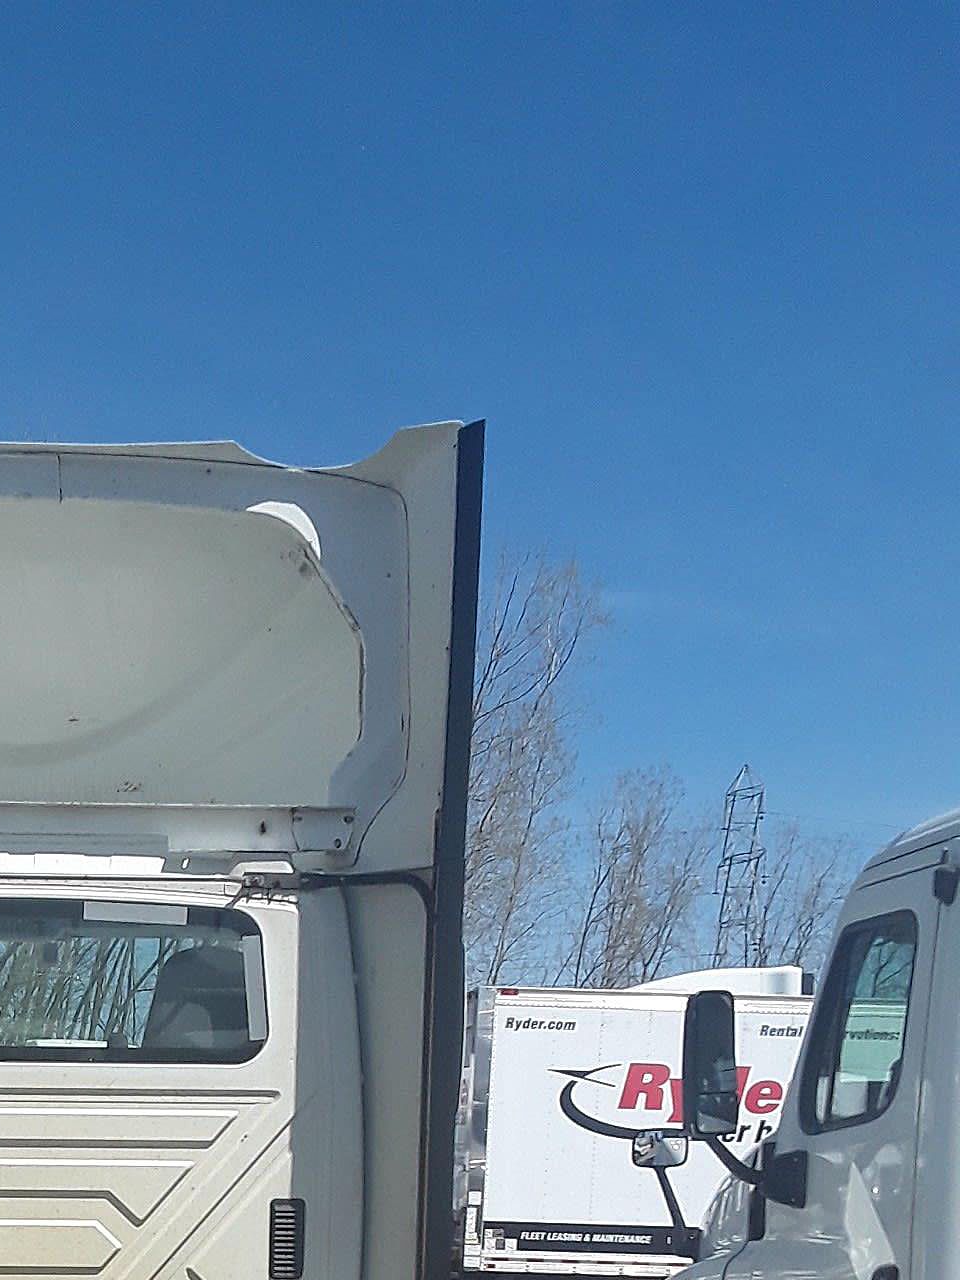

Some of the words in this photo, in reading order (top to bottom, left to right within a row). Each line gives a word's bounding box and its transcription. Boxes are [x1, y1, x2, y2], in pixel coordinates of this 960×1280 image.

[504, 1016, 577, 1032] Ryder.com
[759, 1024, 804, 1038] Rental
[520, 1231, 547, 1241] FLEET
[546, 1231, 583, 1242] LEASING
[583, 1233, 592, 1242] &
[591, 1233, 653, 1245] MAINTENANCE
